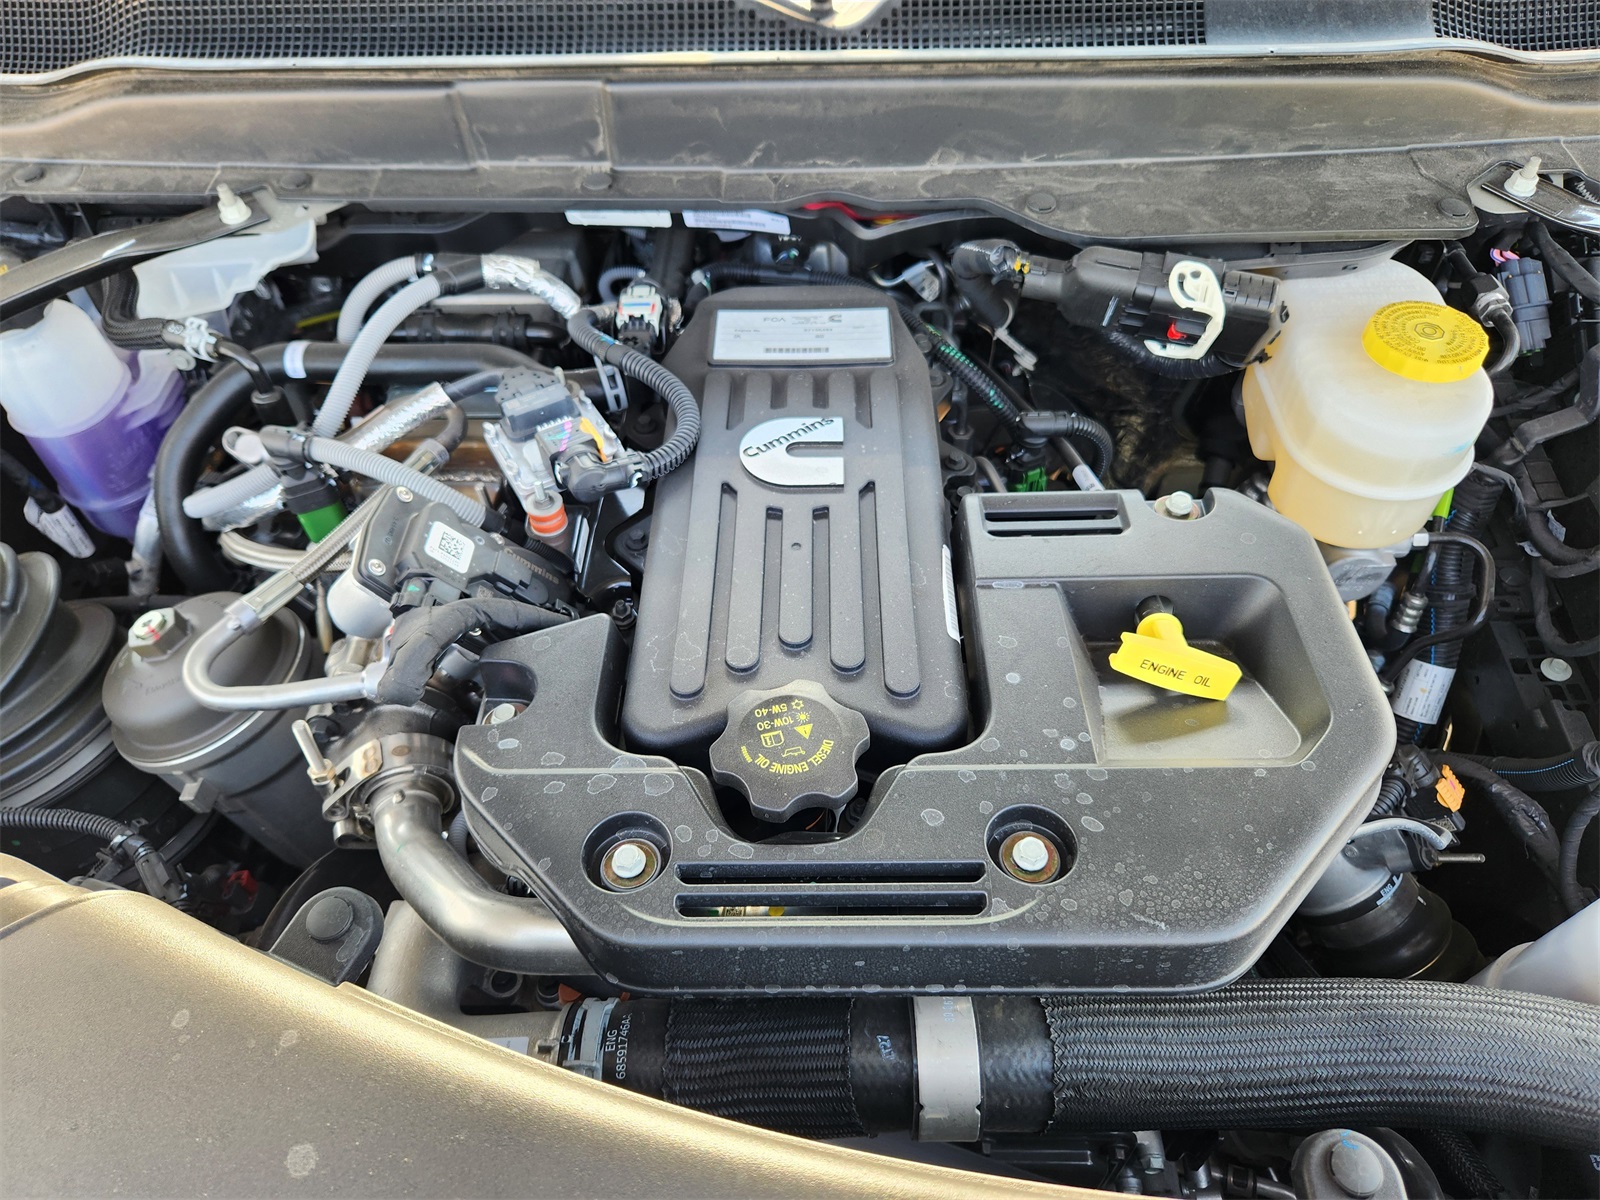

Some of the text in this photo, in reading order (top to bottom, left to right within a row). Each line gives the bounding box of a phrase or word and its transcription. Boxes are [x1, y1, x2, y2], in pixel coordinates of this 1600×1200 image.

[742, 417, 835, 458] Cummins
[503, 546, 561, 586] Cummins
[1139, 659, 1211, 688] ENGINE OIL
[754, 702, 788, 718] 5W-40
[756, 715, 794, 731] 10W-30
[754, 753, 770, 769] OIL
[808, 738, 835, 767] DIESEL
[769, 762, 810, 775] ENGINE
[1379, 883, 1393, 897] ENG
[605, 1029, 618, 1052] ENG
